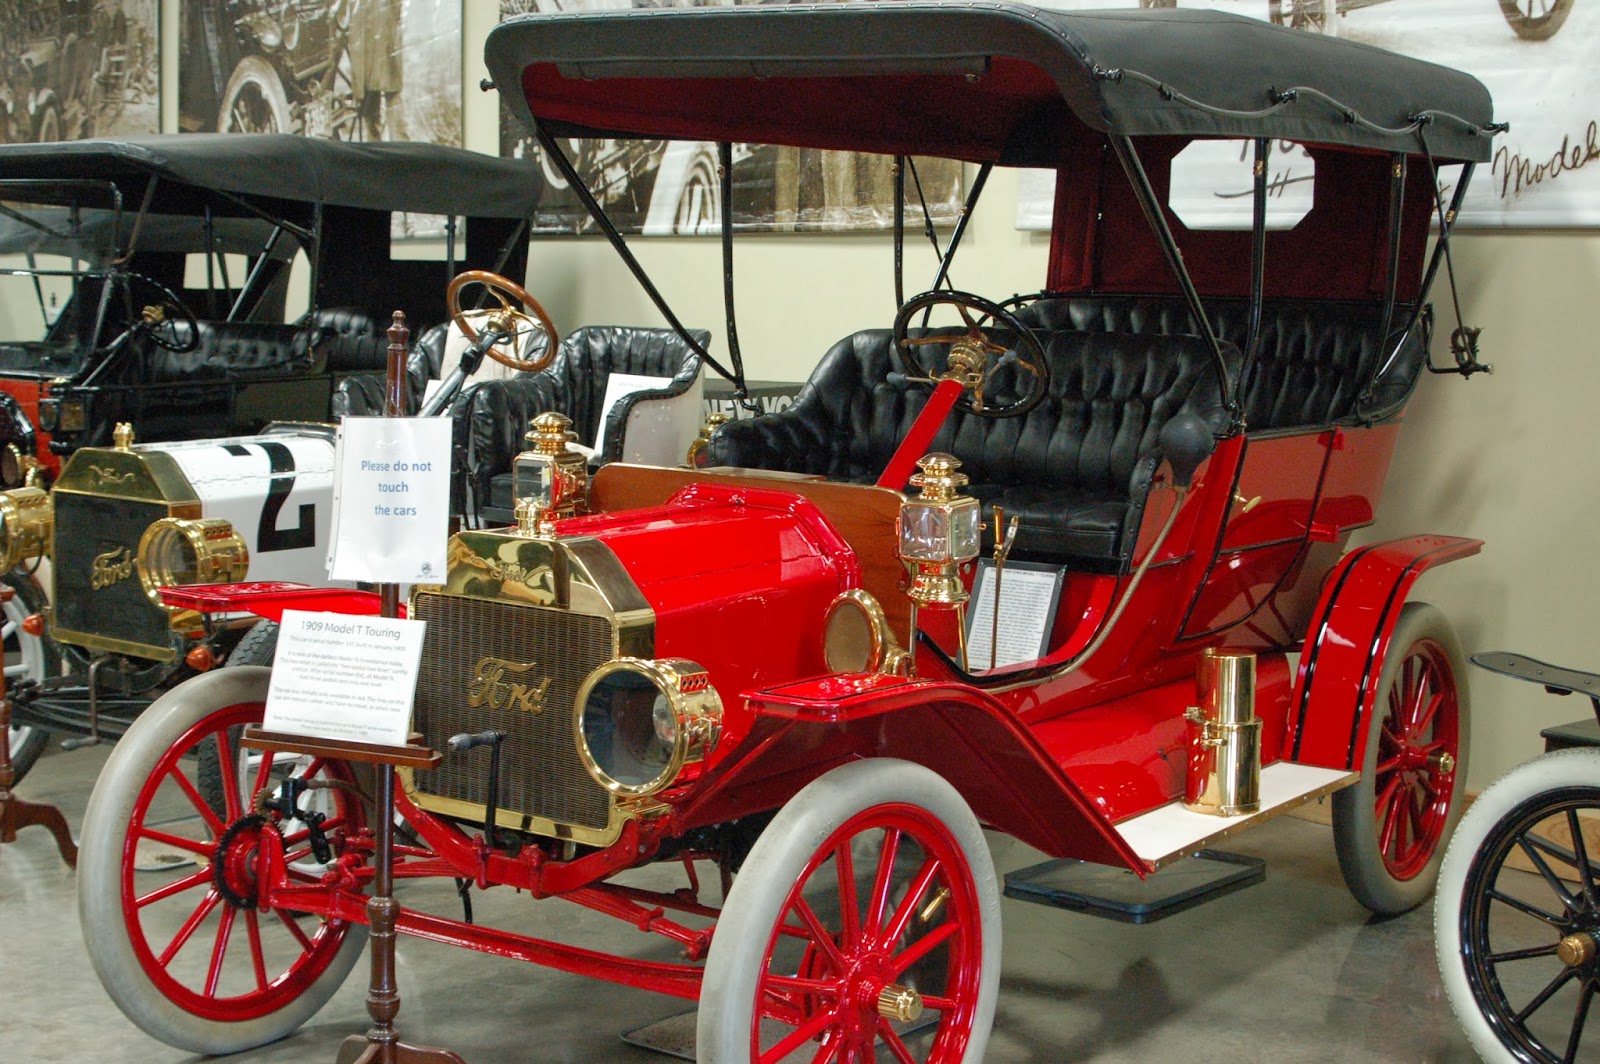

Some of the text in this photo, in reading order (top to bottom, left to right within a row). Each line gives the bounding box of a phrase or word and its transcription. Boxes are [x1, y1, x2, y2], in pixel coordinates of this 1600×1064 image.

[1492, 120, 1600, 199] Model
[361, 460, 432, 472] Please do not
[378, 482, 409, 492] touch
[374, 504, 417, 516] the cars
[91, 545, 133, 591] Ford
[302, 620, 401, 640] 1909 Model T Touring
[467, 657, 552, 716] Ford
